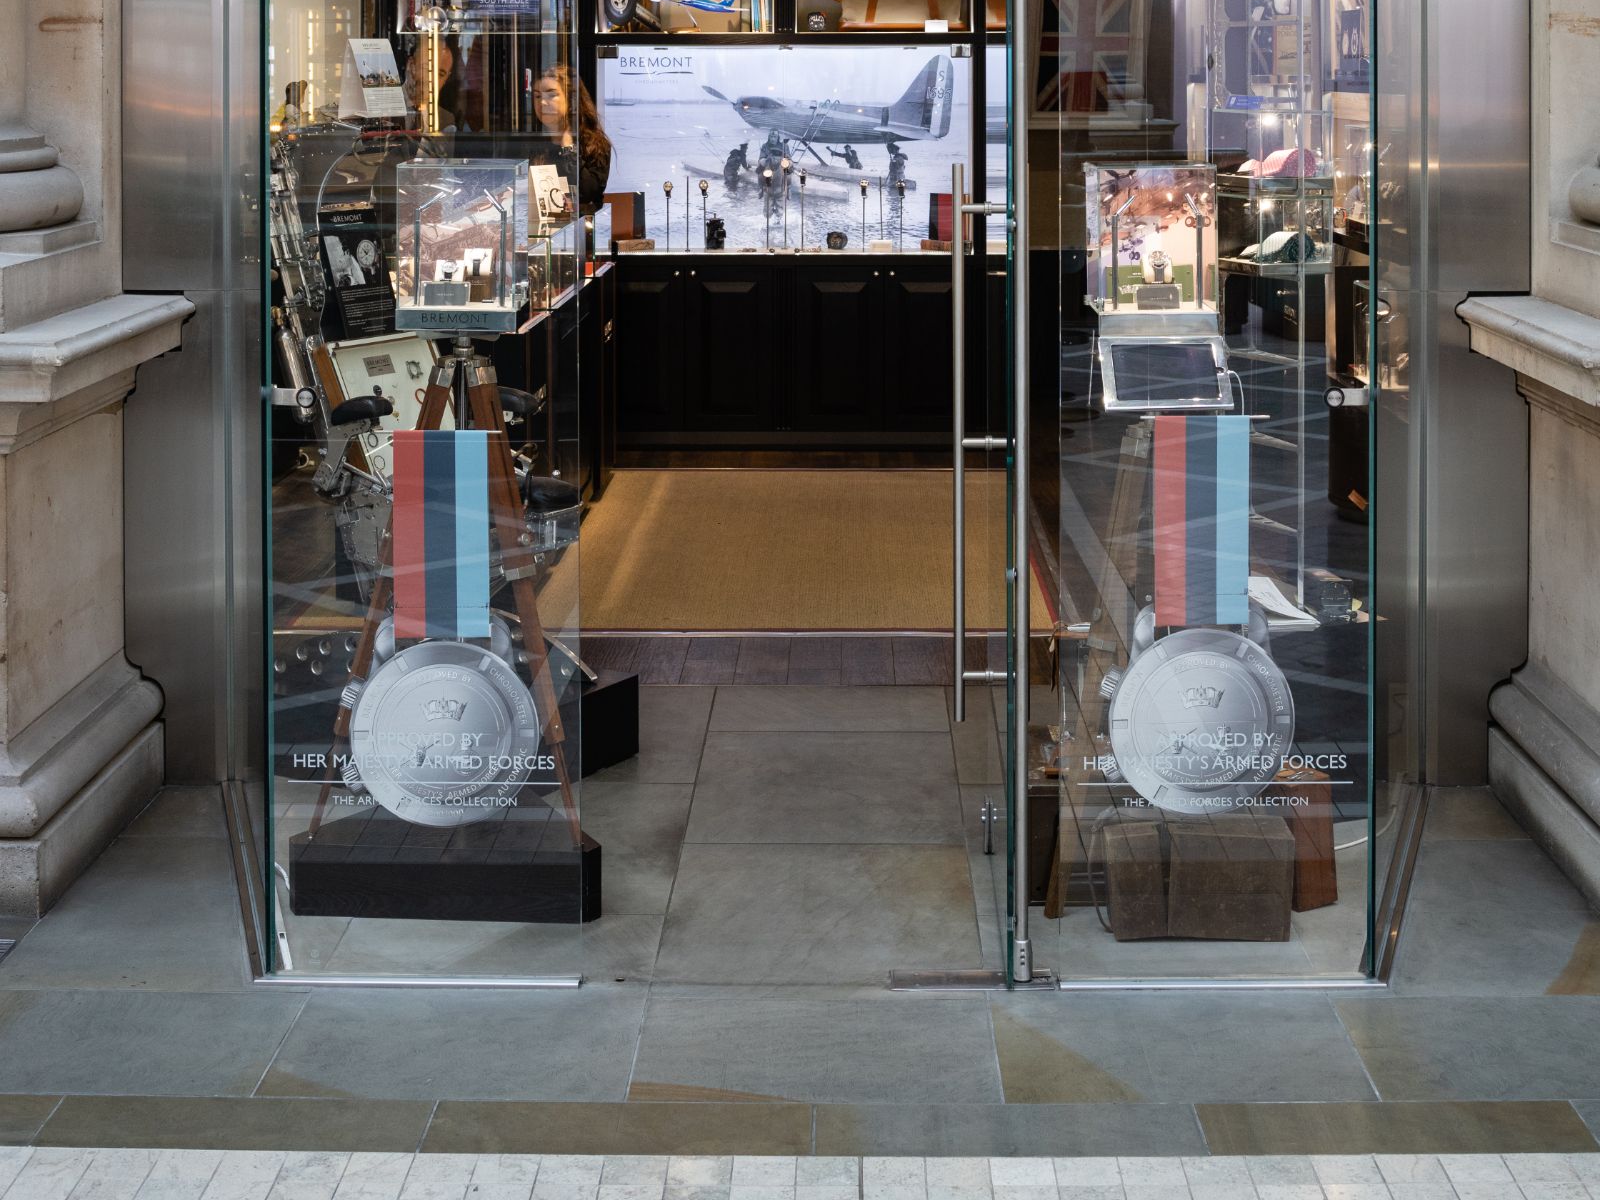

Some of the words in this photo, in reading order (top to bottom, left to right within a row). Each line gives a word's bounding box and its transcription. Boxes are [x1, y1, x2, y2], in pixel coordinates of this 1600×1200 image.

[620, 56, 692, 67] BREMONT
[938, 70, 945, 81] S
[332, 213, 362, 223] BREMONT
[421, 313, 489, 324] BREMONT
[1247, 655, 1284, 712] CHRONOMETER
[489, 667, 528, 725] CHRONOMETER
[367, 733, 455, 747] APPROVED
[461, 733, 483, 747] BY
[1157, 732, 1247, 747] APPROVED
[1253, 732, 1275, 747] BY
[293, 754, 327, 768] HER
[333, 754, 418, 771] MAJESTY'S
[421, 755, 483, 770] ARMED
[489, 755, 556, 770] FORCES
[1124, 755, 1208, 772] MAJESTY'S
[1211, 755, 1275, 769] ARMED
[1280, 754, 1347, 769] FORCES
[448, 785, 477, 800] ARMED
[332, 796, 355, 806] THE
[444, 796, 518, 807] COLLECTION
[1122, 797, 1145, 807] THE
[1190, 797, 1233, 807] FORCES
[1235, 796, 1309, 807] COLLECTION
